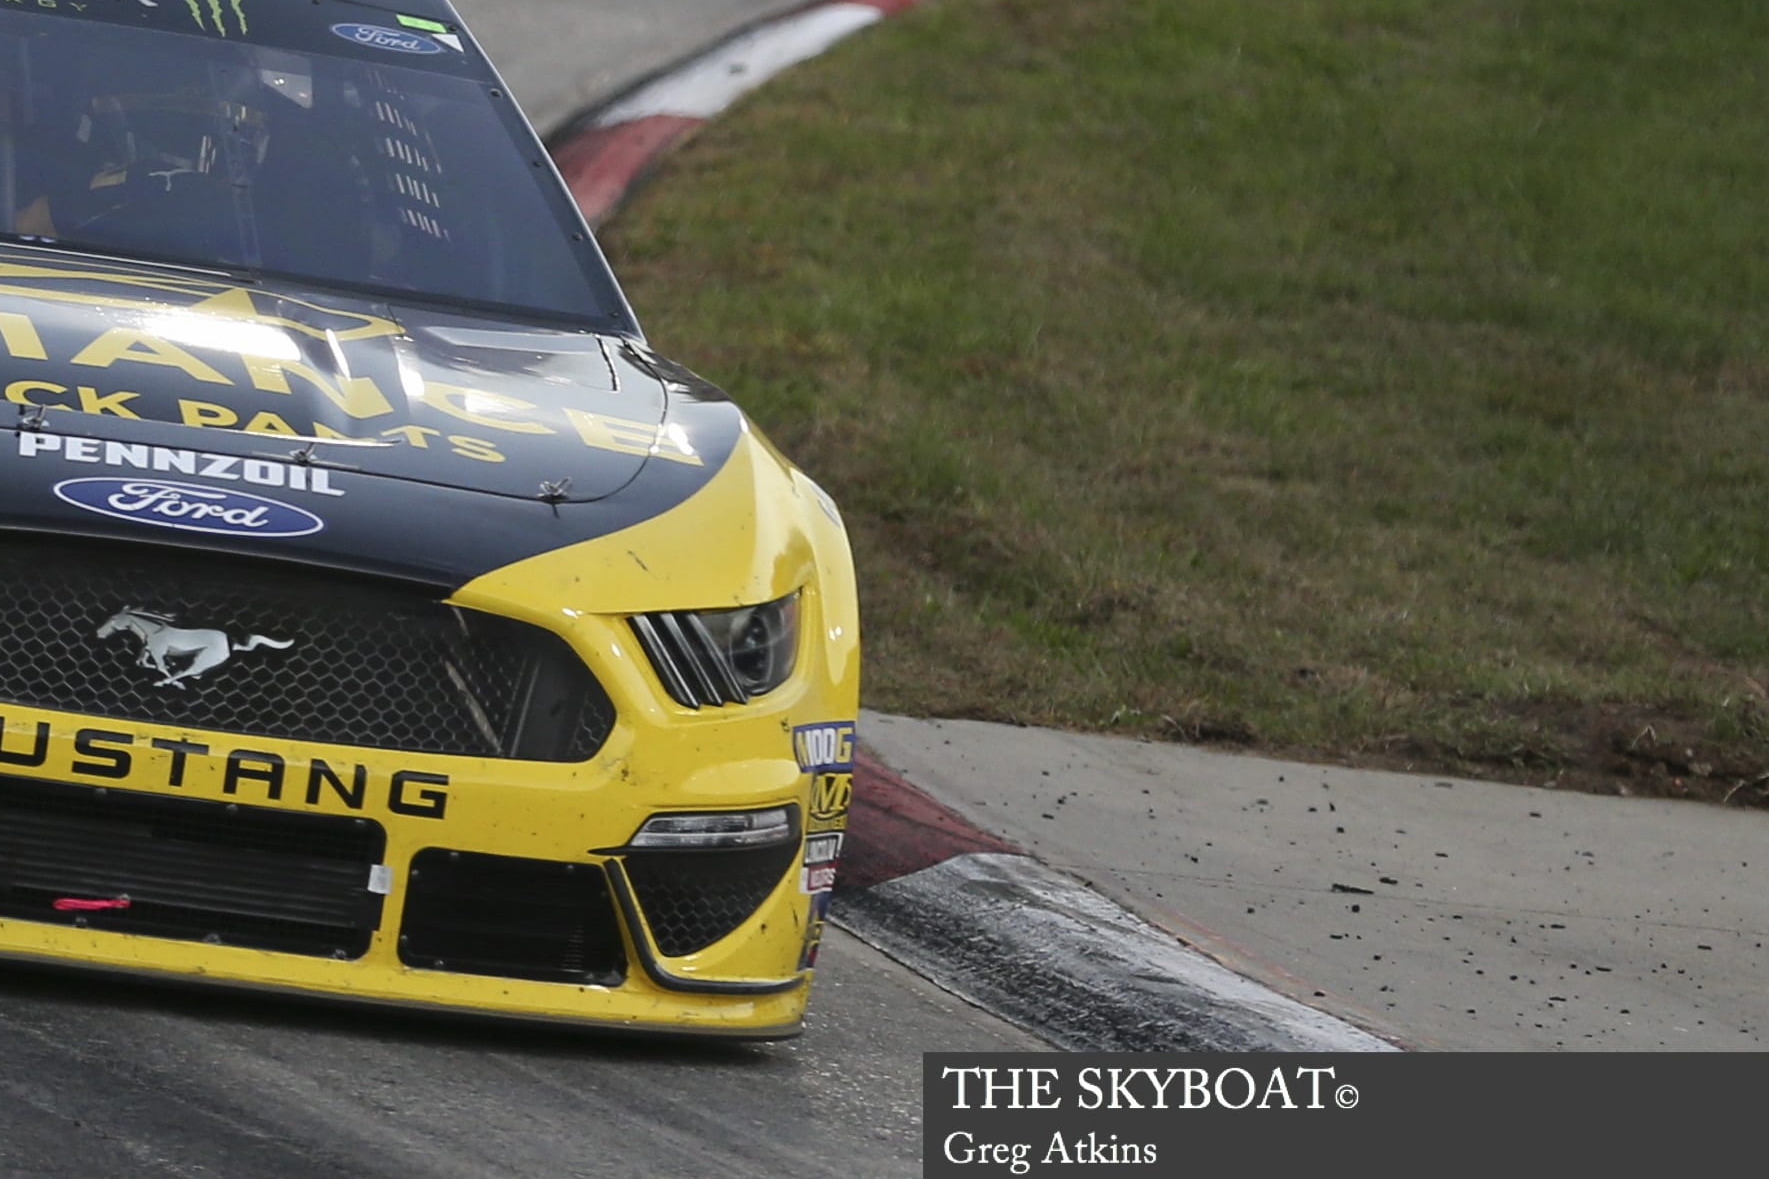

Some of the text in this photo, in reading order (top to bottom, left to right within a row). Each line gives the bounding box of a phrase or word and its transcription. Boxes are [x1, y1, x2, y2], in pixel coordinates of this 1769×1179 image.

[354, 27, 421, 50] Ford
[19, 430, 346, 497] PENNZOIL
[107, 482, 270, 528] Ford
[796, 727, 853, 768] MOOG
